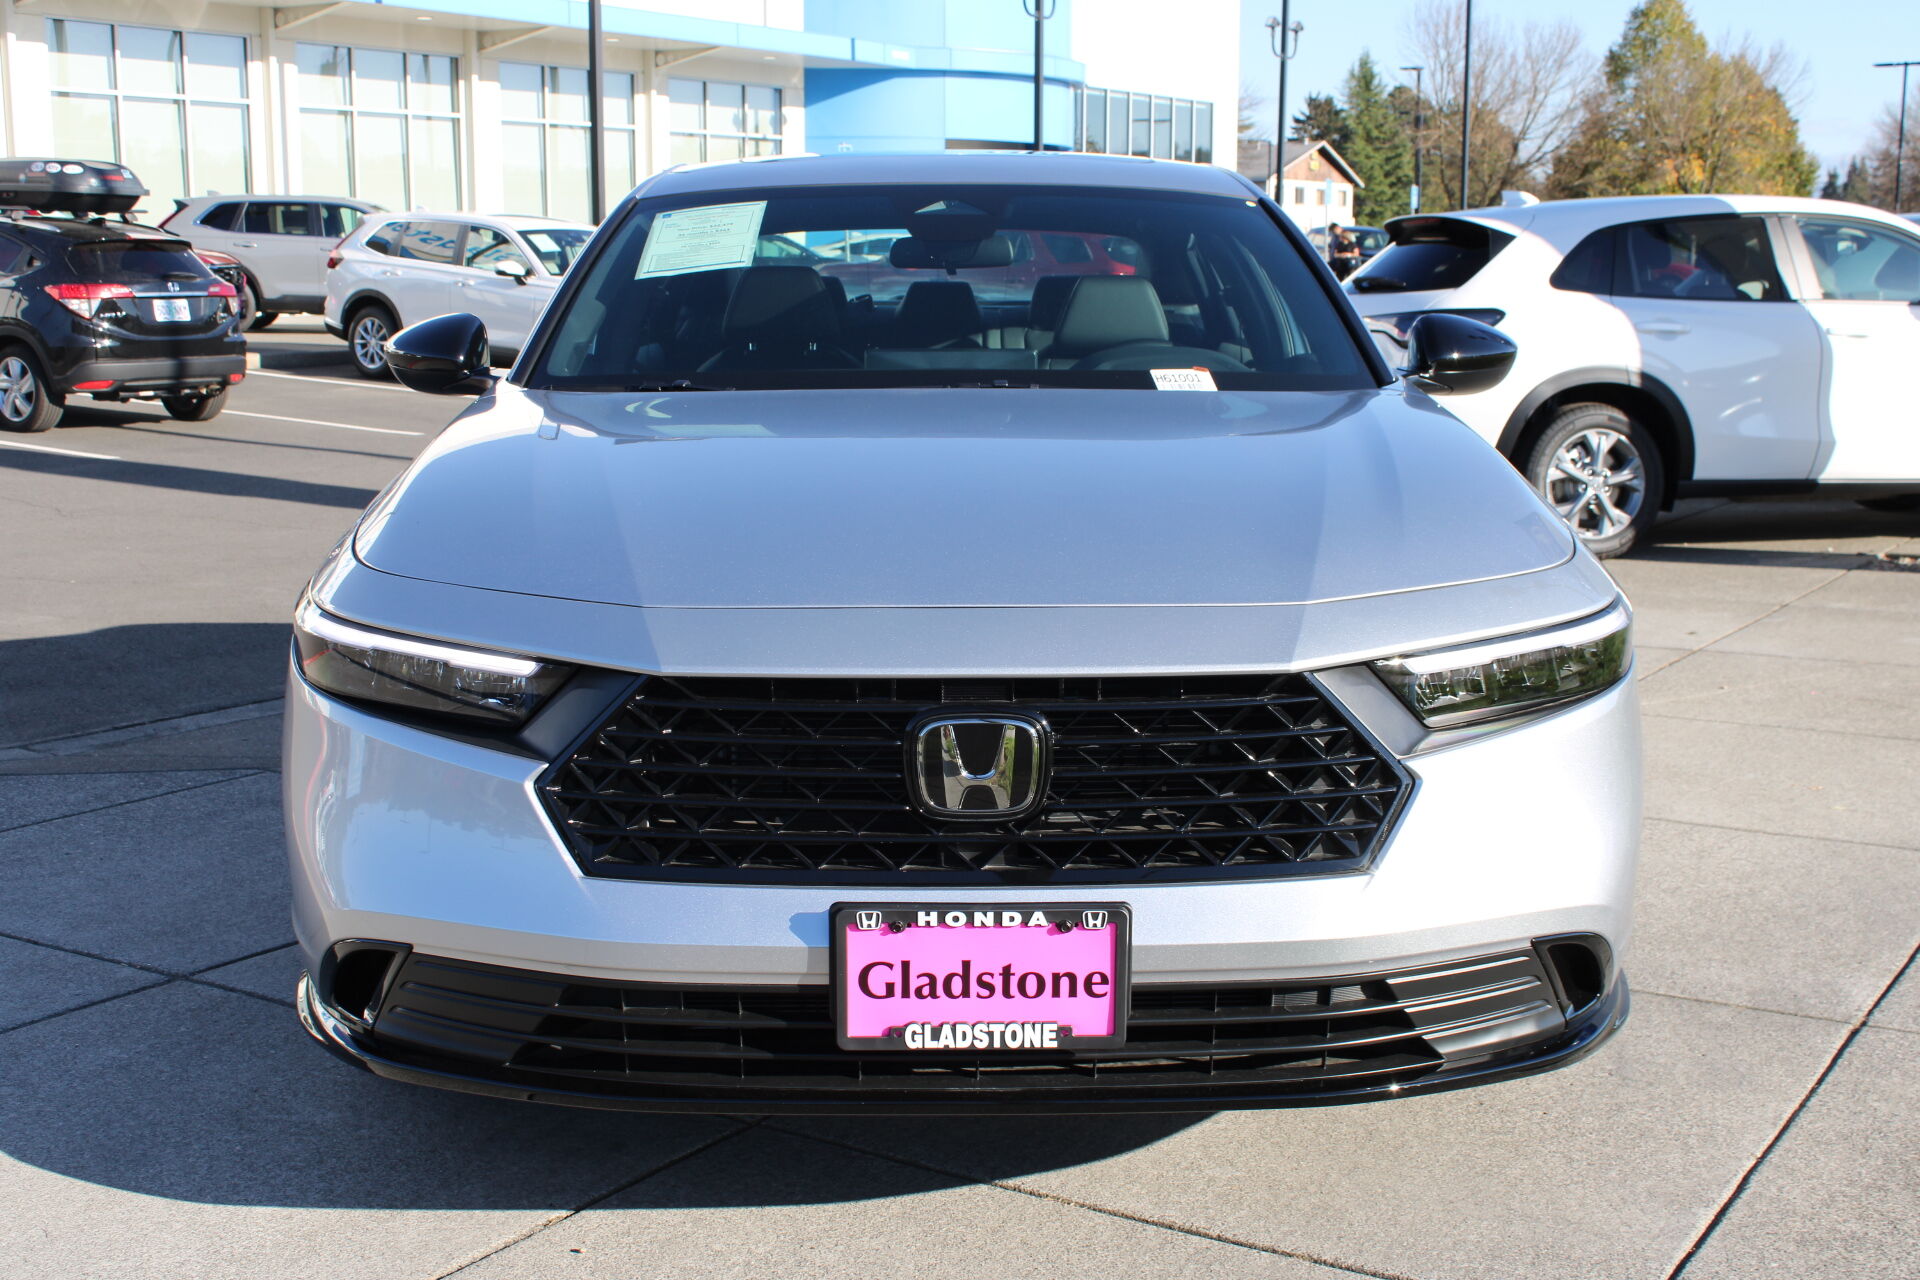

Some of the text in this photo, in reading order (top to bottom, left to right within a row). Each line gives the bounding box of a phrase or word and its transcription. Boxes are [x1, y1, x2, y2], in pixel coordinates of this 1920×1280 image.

[916, 911, 1050, 927] HONDA
[857, 959, 1111, 1000] Gladstone
[904, 1022, 1059, 1049] GLADSTONE
